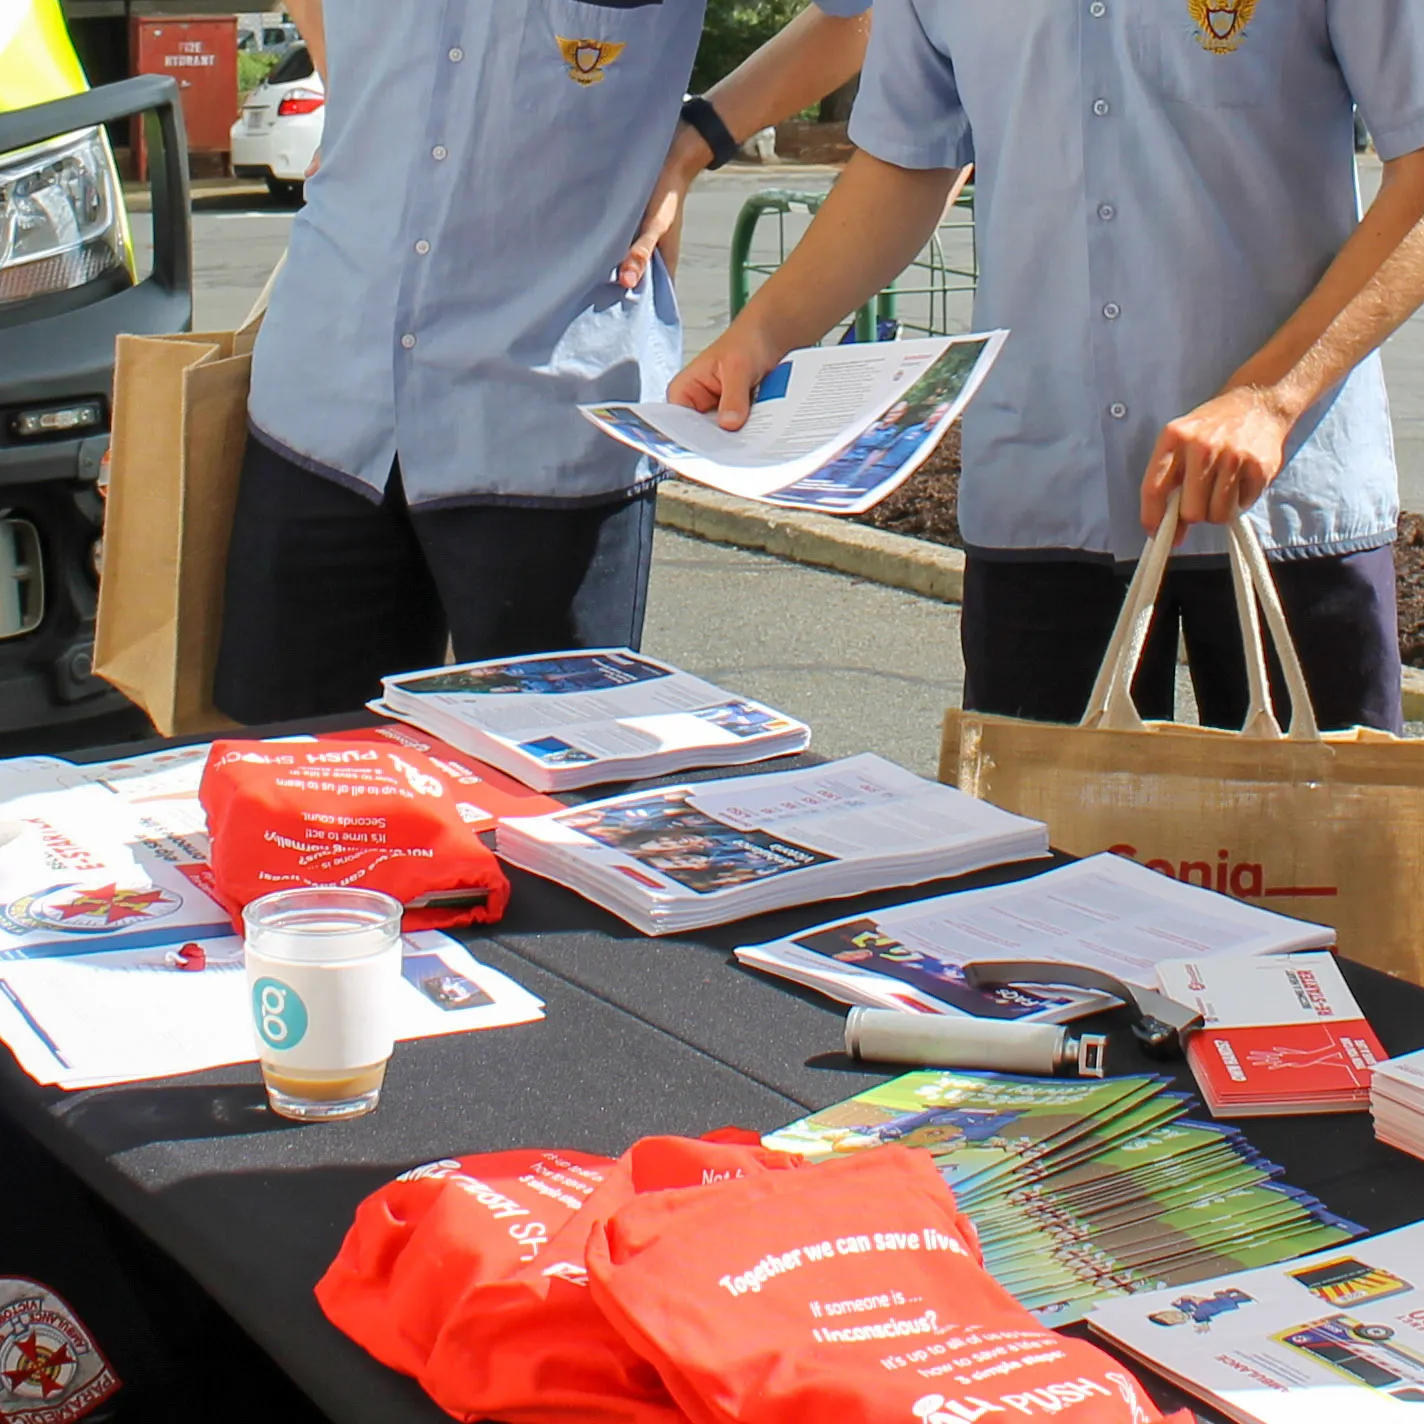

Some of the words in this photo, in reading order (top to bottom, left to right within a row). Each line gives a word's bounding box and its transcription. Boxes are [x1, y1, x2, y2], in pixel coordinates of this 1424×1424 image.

[178, 42, 203, 53] FIRE
[164, 55, 216, 67] HYDRANT
[305, 749, 380, 764] PUSH
[274, 778, 306, 792] learn
[306, 781, 320, 791] to
[321, 782, 335, 792] us
[336, 784, 349, 795] of
[350, 784, 365, 796] all
[367, 785, 380, 795] to
[380, 785, 397, 796] up
[398, 787, 414, 799] It's
[337, 815, 387, 829] Seconds
[304, 829, 325, 841] act!
[327, 831, 340, 842] to
[342, 832, 368, 844] time
[374, 833, 387, 844] It's
[1296, 970, 1335, 1017] RE-STARTER
[717, 1248, 805, 1297] Together
[803, 1240, 835, 1262] we
[835, 1234, 872, 1255] can
[872, 1232, 921, 1251] save
[808, 1301, 822, 1319] If
[823, 1292, 891, 1317] someone
[890, 1289, 906, 1306] is
[29, 1310, 86, 1352] AMBULANCE
[880, 1353, 906, 1371] It's
[906, 1348, 928, 1364] up
[927, 1342, 947, 1356] to
[946, 1336, 967, 1351] all
[966, 1333, 983, 1346] of
[916, 1363, 953, 1379] how
[953, 1356, 973, 1368] to
[972, 1346, 1008, 1363] save
[952, 1374, 972, 1386] 3
[971, 1360, 1023, 1382] simple
[1000, 1377, 1112, 1416] PUSH
